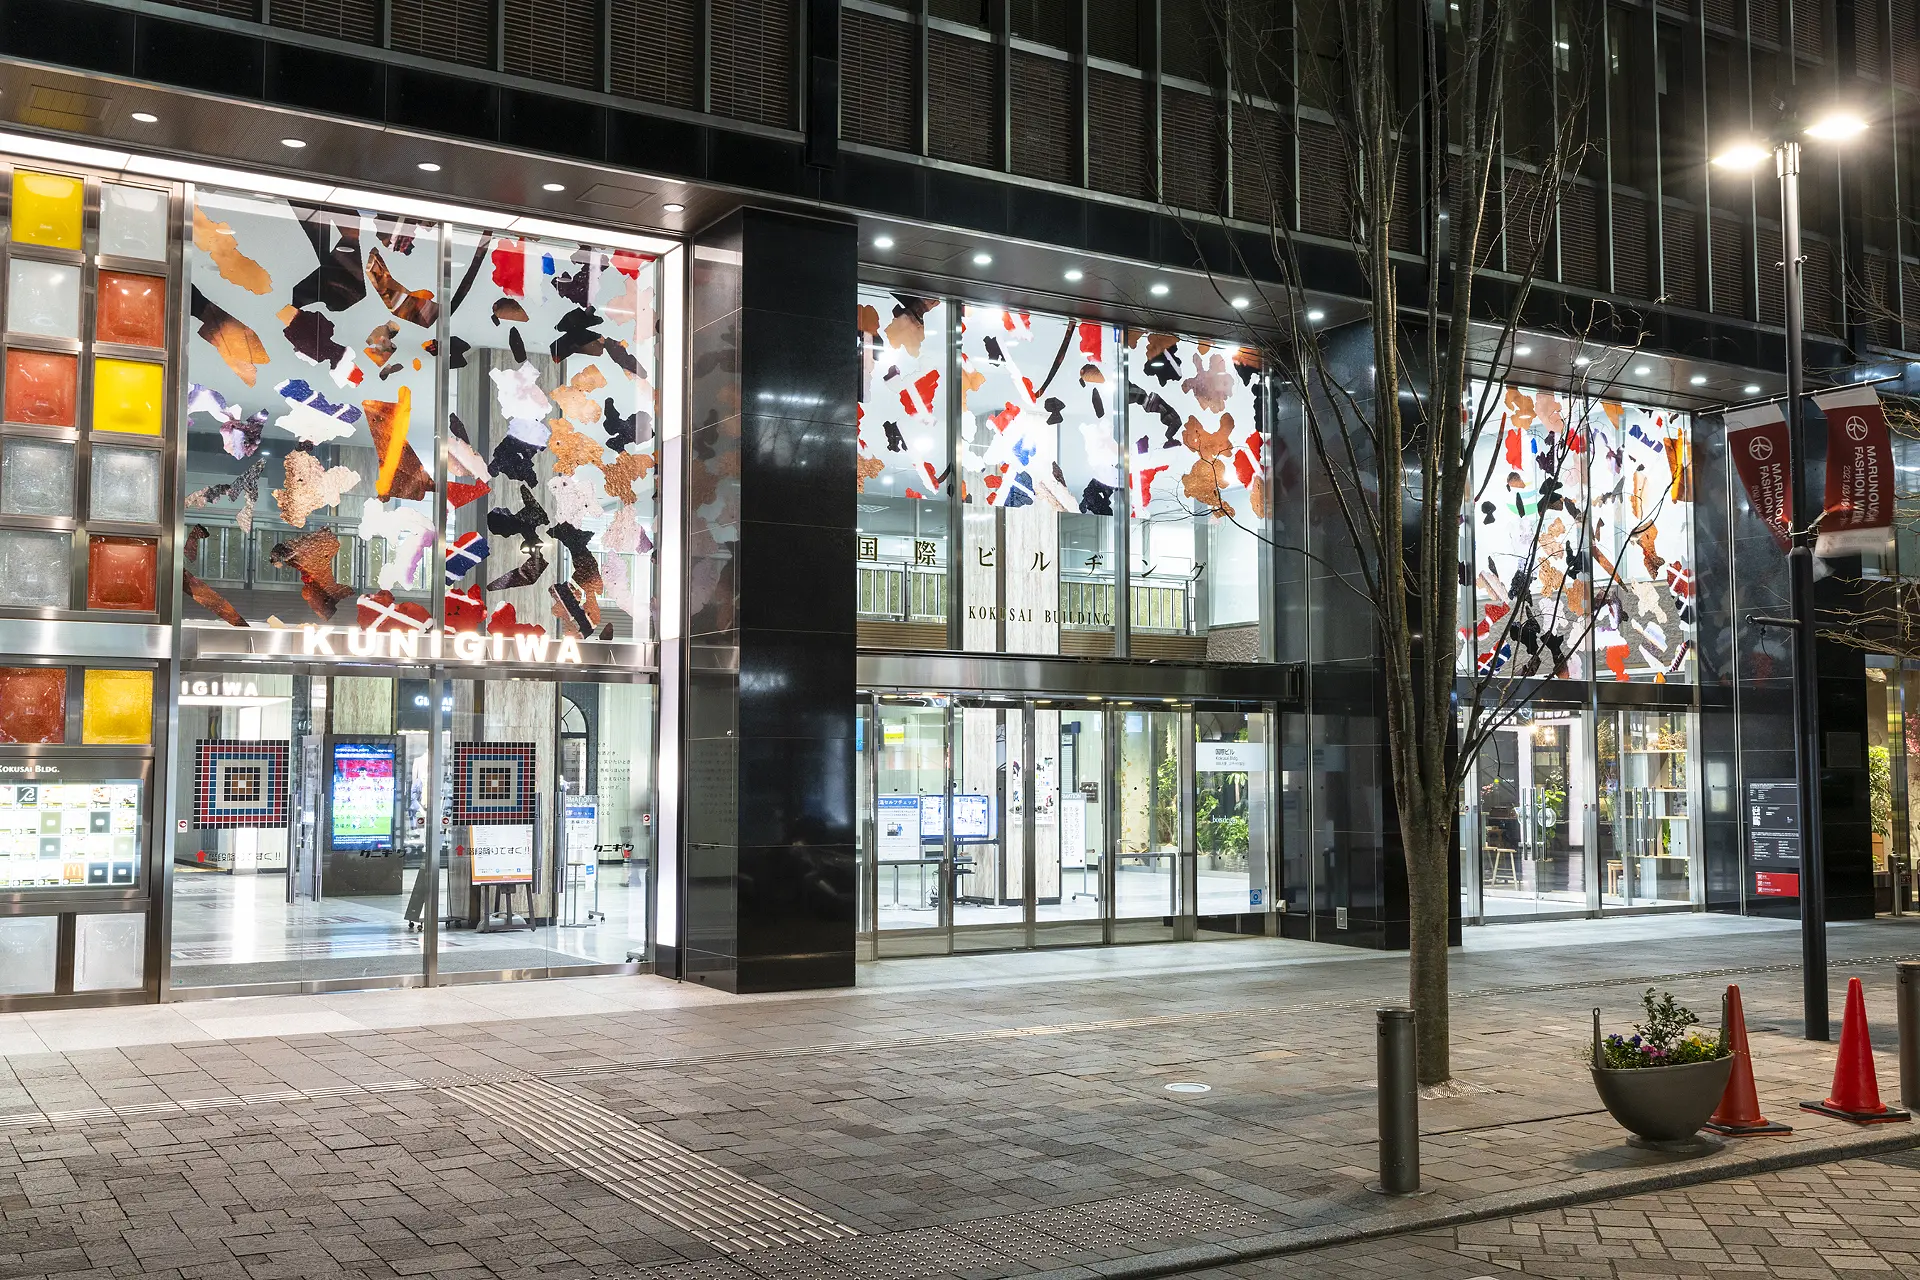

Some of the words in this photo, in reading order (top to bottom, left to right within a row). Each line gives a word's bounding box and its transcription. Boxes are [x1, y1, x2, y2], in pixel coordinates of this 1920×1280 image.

[1759, 465, 1774, 515] FASHION
[1854, 446, 1866, 497] FASHION
[857, 536, 1208, 582] 国際ビルヂング
[968, 606, 1032, 622] KOKUSAI
[1045, 610, 1110, 626] BUILDING
[303, 626, 583, 664] KUNIGIWA
[181, 680, 259, 697] IGIWA
